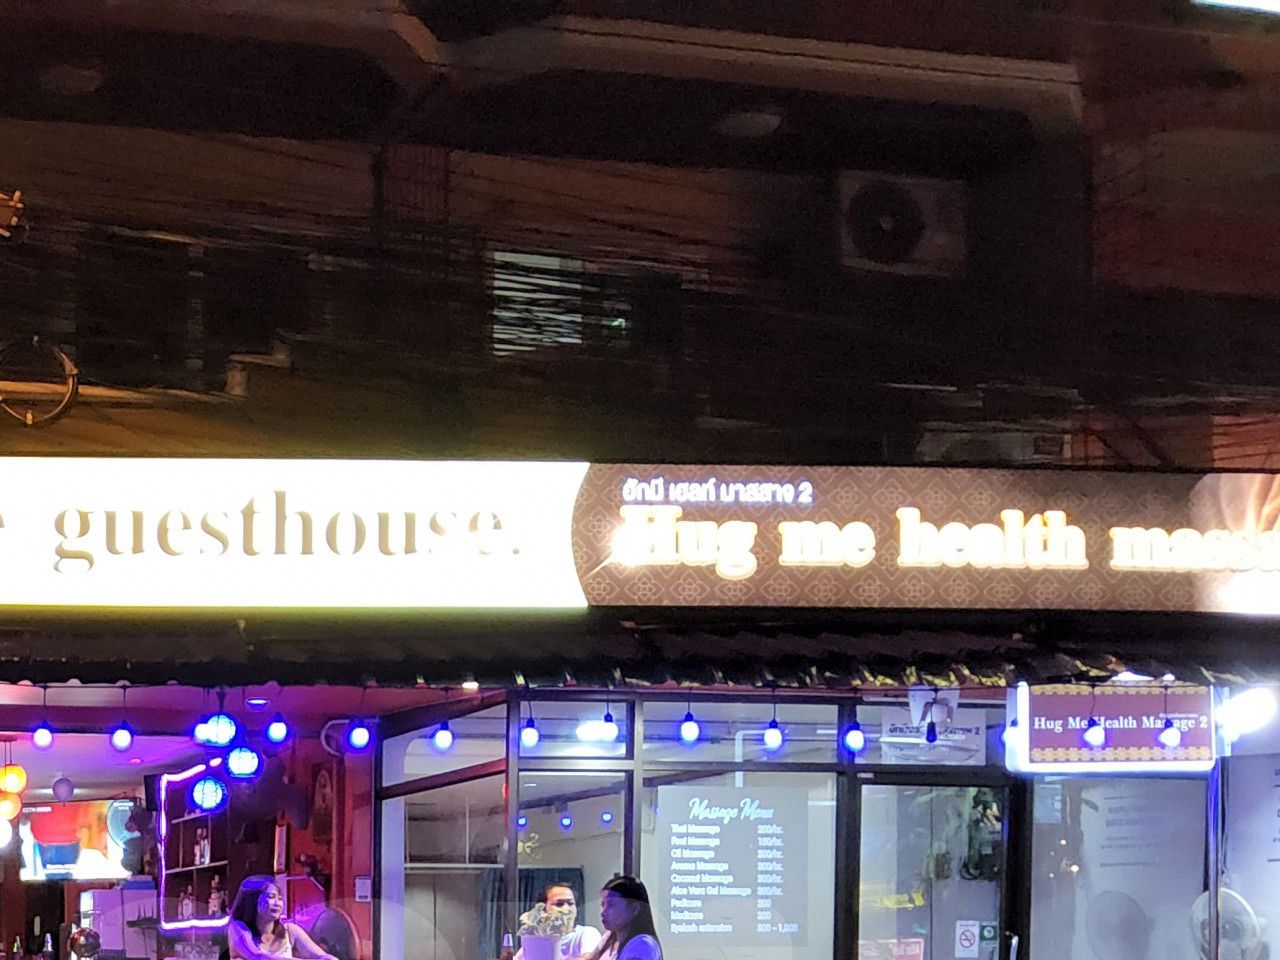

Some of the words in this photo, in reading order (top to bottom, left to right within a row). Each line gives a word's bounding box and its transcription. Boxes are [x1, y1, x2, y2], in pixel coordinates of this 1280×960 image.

[798, 481, 813, 502] 2
[619, 505, 758, 580] Hug
[778, 520, 876, 568] me
[896, 506, 1088, 570] health
[1034, 717, 1063, 733] Hug
[1067, 717, 1088, 729] Me
[1093, 716, 1137, 729] Health
[1200, 716, 1208, 729] 2
[688, 798, 738, 824] Massage
[740, 798, 775, 820] Menu
